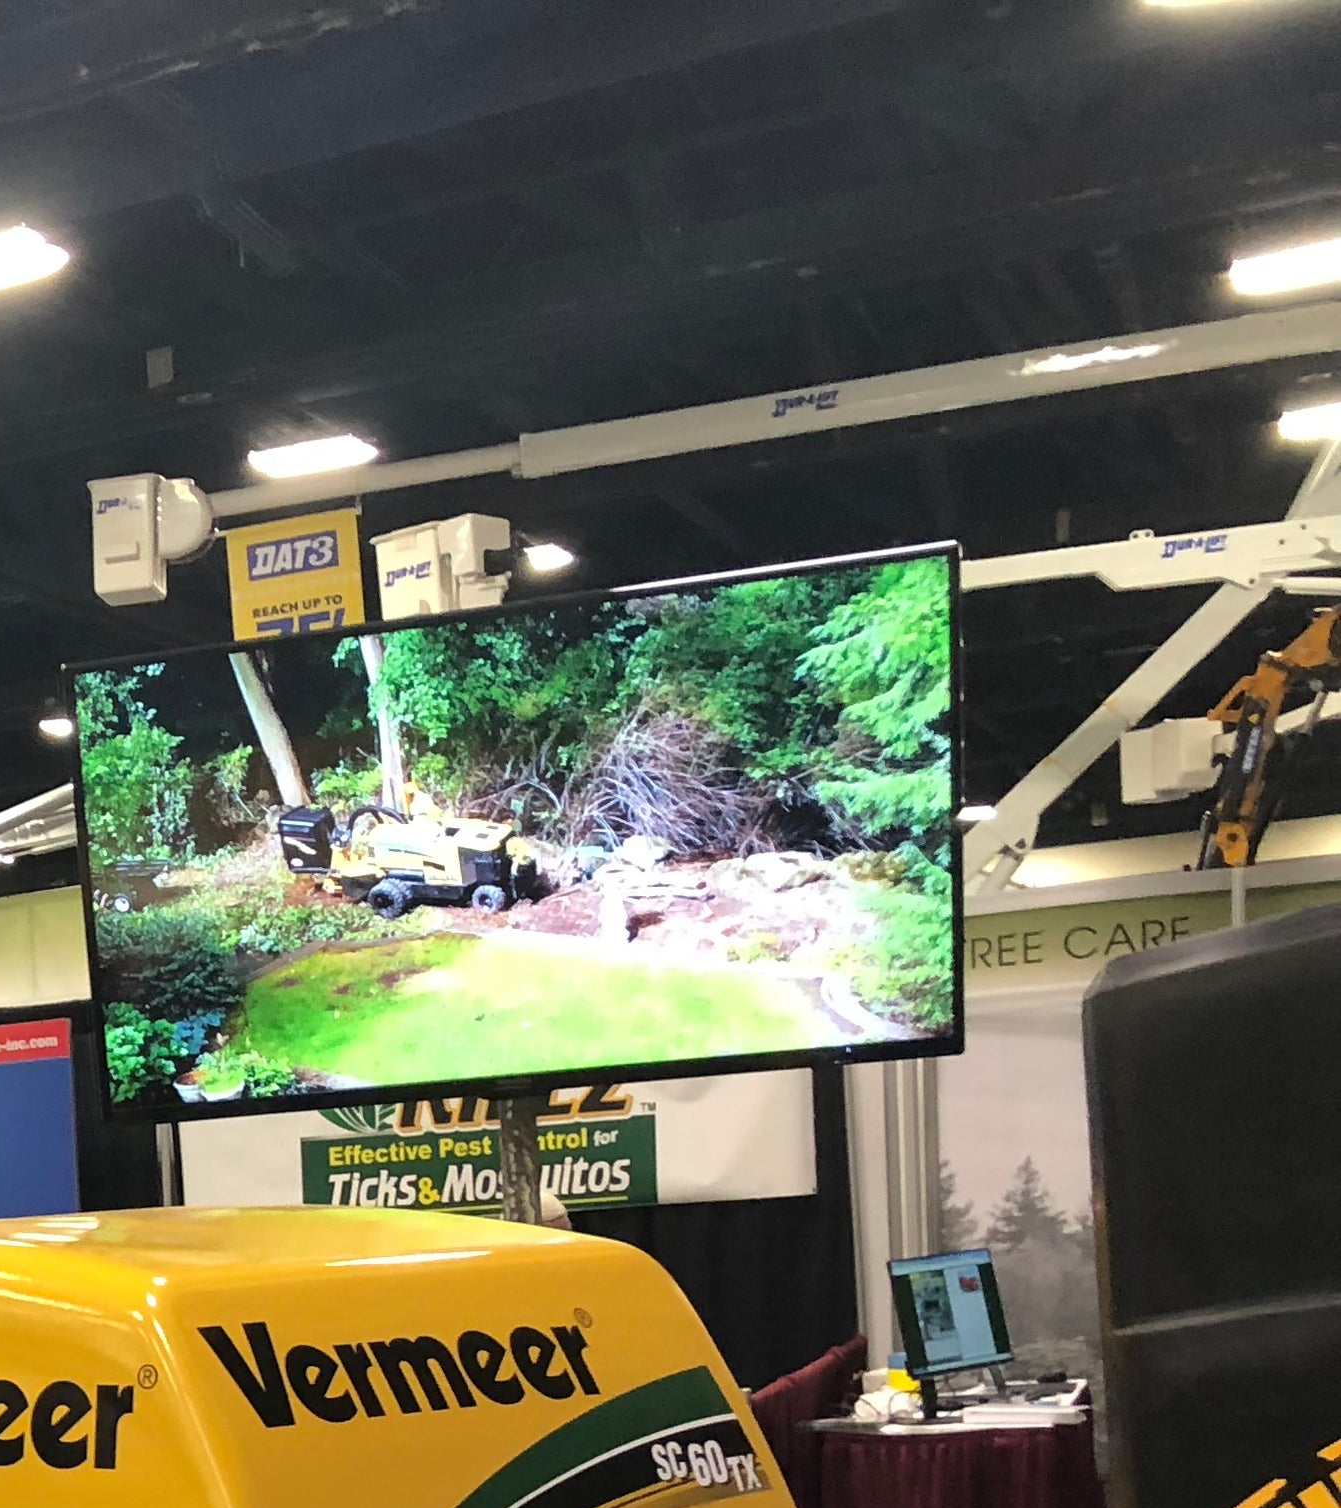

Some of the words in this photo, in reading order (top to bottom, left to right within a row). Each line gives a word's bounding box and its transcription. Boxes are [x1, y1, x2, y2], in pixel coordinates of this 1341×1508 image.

[251, 535, 334, 577] DAT3
[252, 601, 299, 619] REACH
[302, 597, 321, 610] UP
[324, 594, 343, 606] TO
[965, 929, 1045, 970] REE
[329, 1141, 432, 1168] Effective
[439, 1136, 493, 1160] Pest
[593, 1129, 619, 1147] for
[197, 1321, 601, 1428] Vermeer
